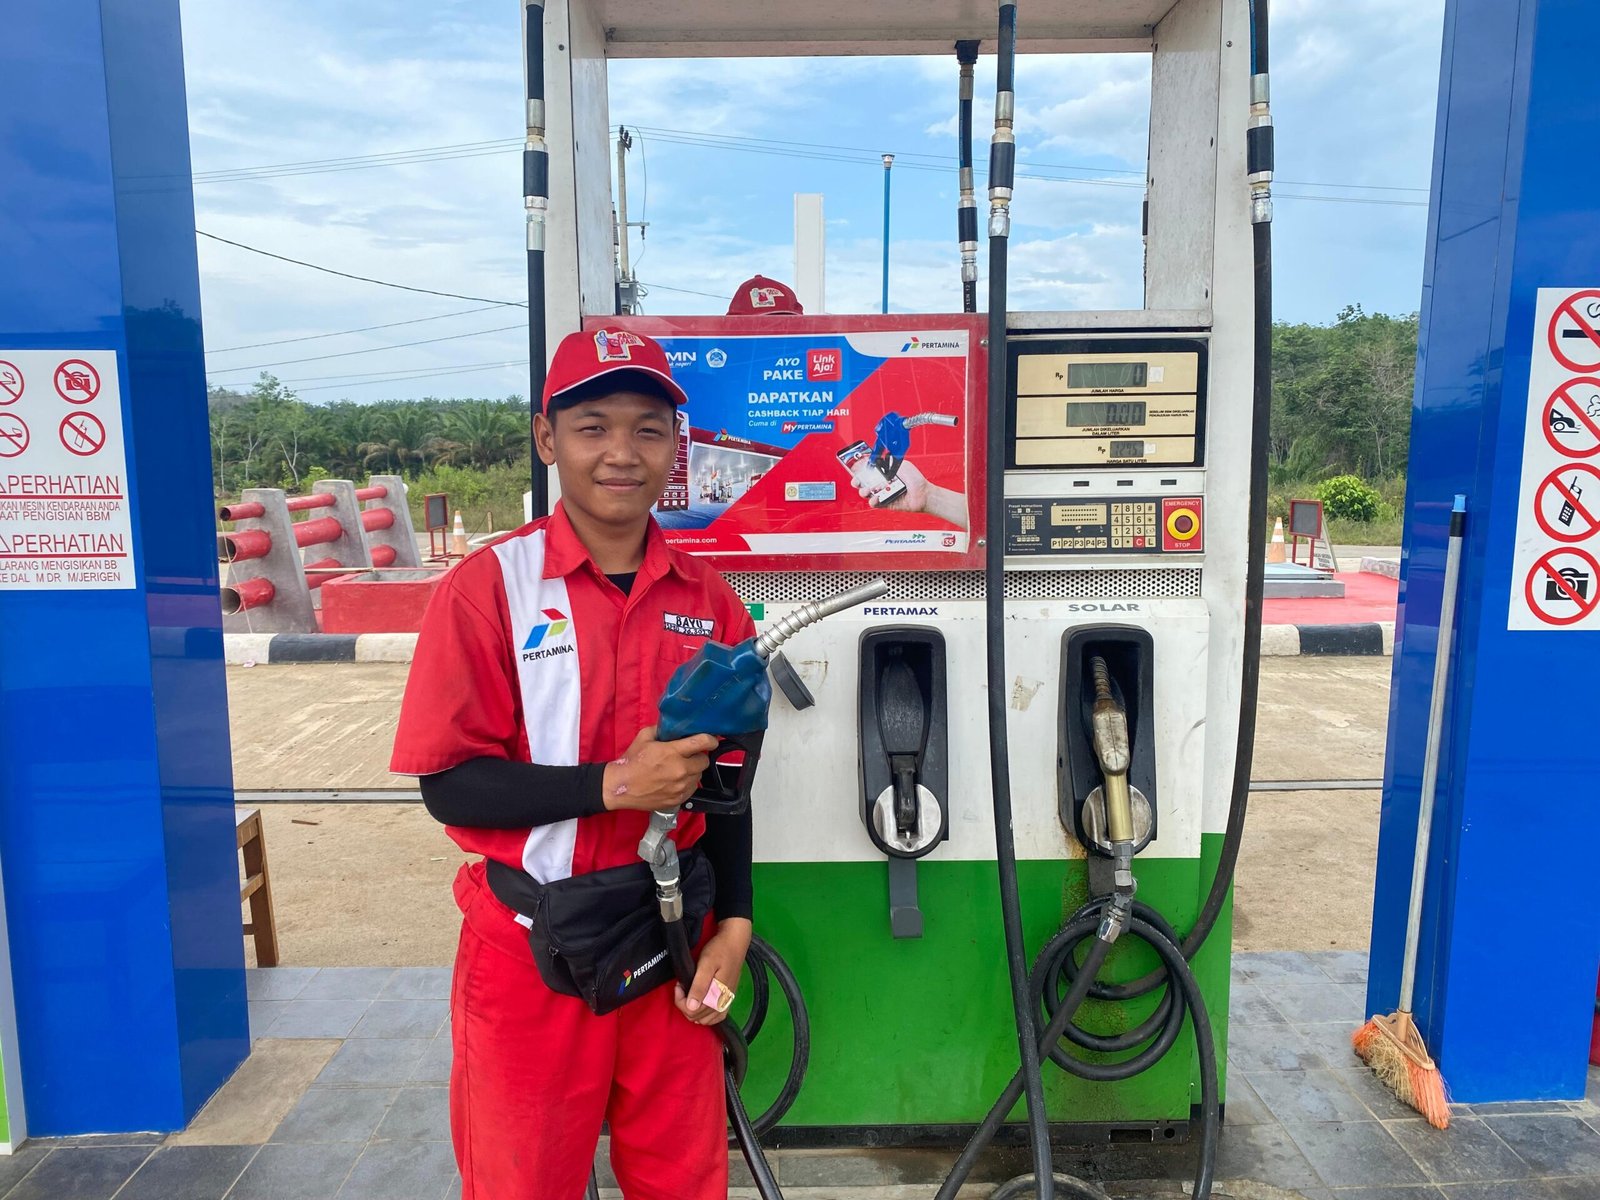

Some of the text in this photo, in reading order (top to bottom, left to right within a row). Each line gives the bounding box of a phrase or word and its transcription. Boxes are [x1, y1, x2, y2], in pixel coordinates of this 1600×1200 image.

[775, 357, 800, 367] AYO
[813, 354, 835, 364] Link
[813, 363, 834, 373] Aja!
[763, 369, 803, 381] PAKE
[748, 391, 833, 404] DAPATKAN
[748, 408, 849, 418] CASHBACK TIAP HARI
[8, 475, 120, 494] PERHATIAN
[20, 501, 45, 511] MESIN
[46, 501, 98, 511] KENDARAAN
[98, 501, 121, 511] ANDA
[23, 511, 83, 521] PENGISIAN
[86, 511, 110, 520] BBM
[12, 533, 124, 553] PERHATIAN
[1097, 539, 1106, 547] P5
[1114, 538, 1119, 546] 0
[1135, 538, 1142, 546] C
[41, 560, 102, 571] MENGISIKAN
[863, 607, 938, 616] PERTAMAX
[1068, 603, 1140, 612] SOLAR
[676, 615, 703, 628] BAYU
[522, 644, 575, 662] PERTAMINA
[633, 948, 670, 979] PERTAMINA
